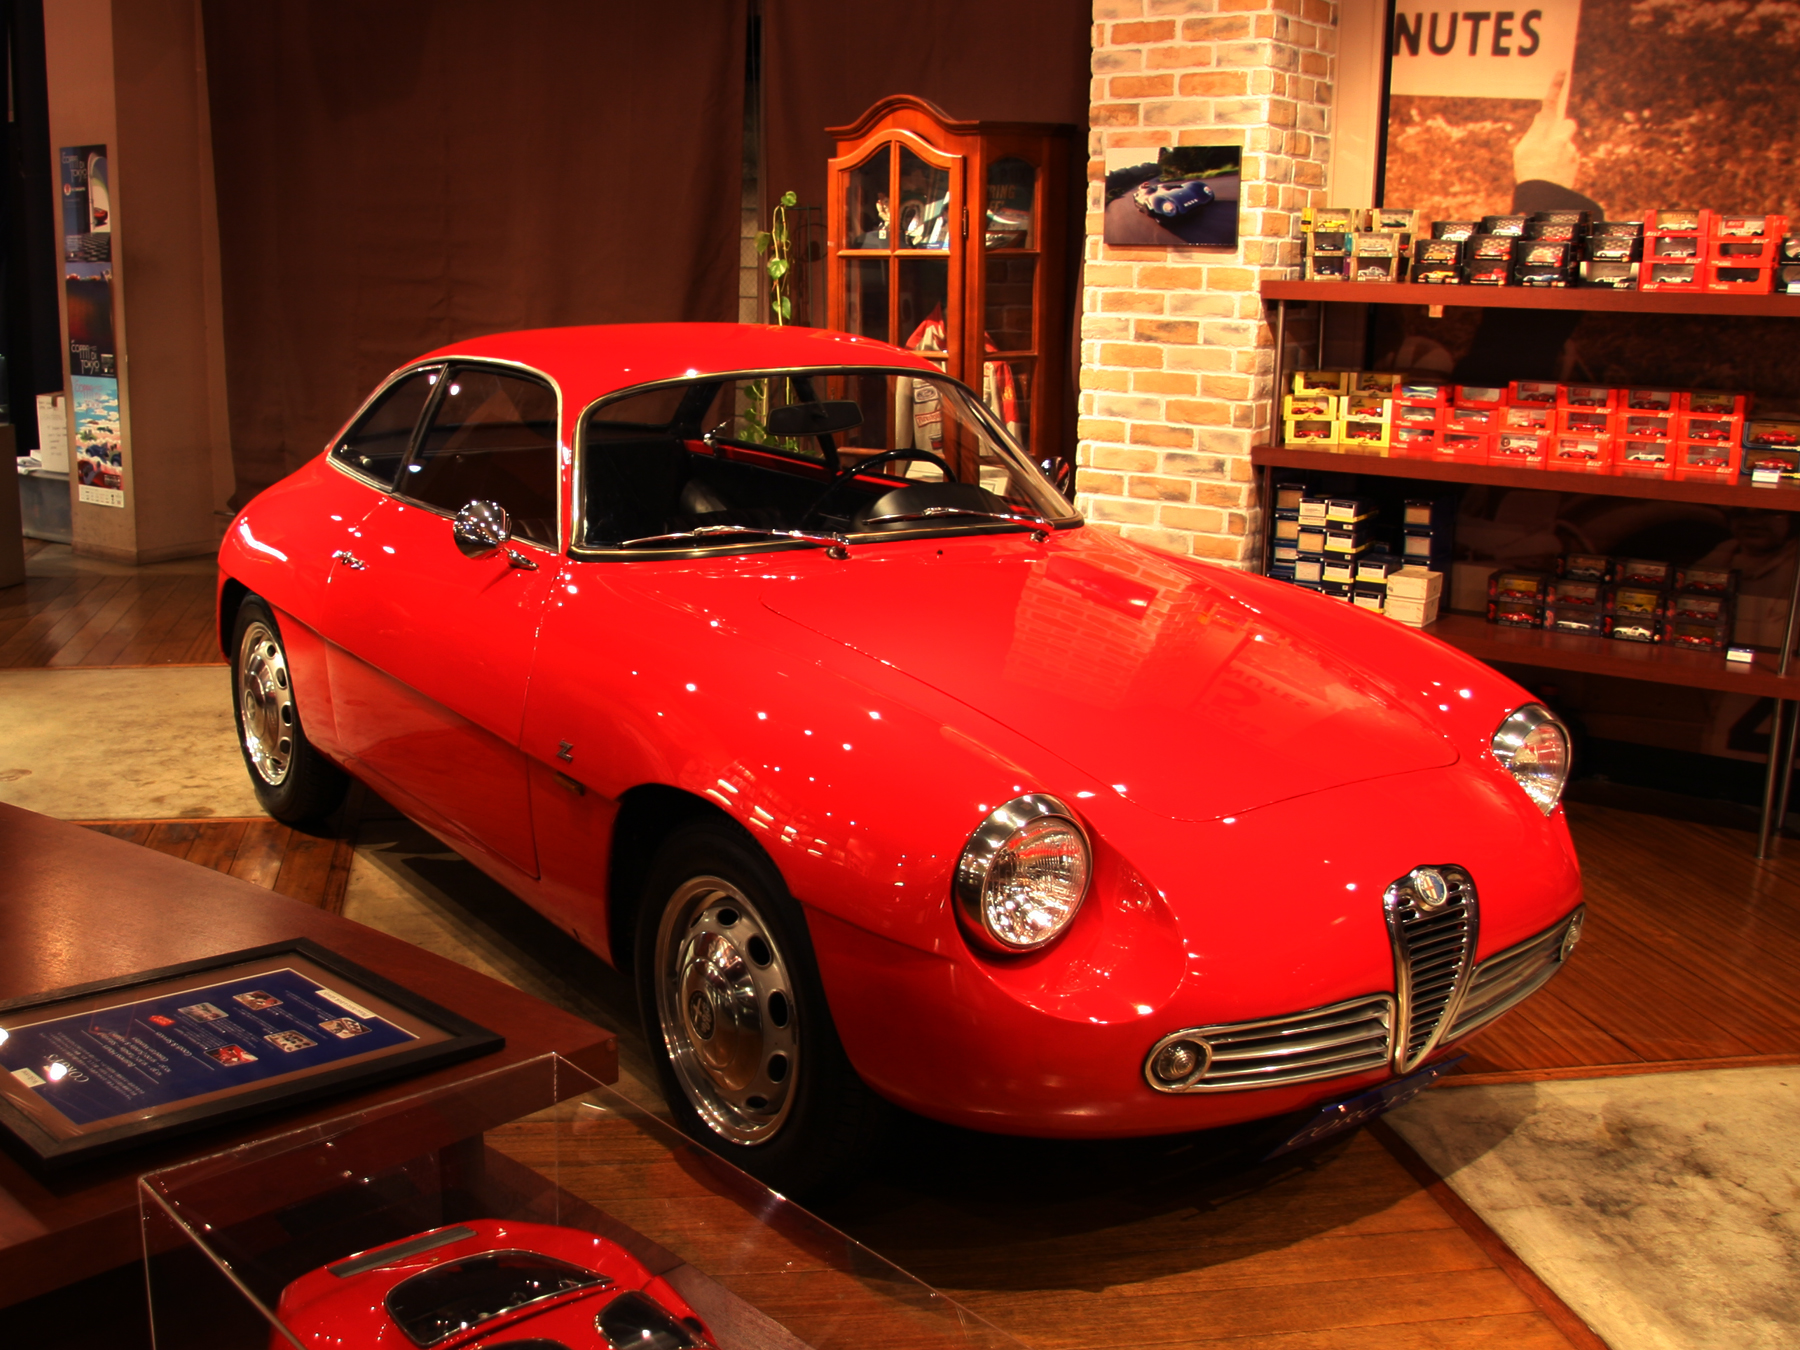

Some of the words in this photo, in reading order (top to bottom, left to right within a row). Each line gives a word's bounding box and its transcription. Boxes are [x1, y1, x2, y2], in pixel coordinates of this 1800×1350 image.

[1393, 9, 1543, 57] NUTES
[70, 344, 90, 360] COPPA
[91, 351, 97, 360] DI
[80, 360, 100, 374] TOKYO
